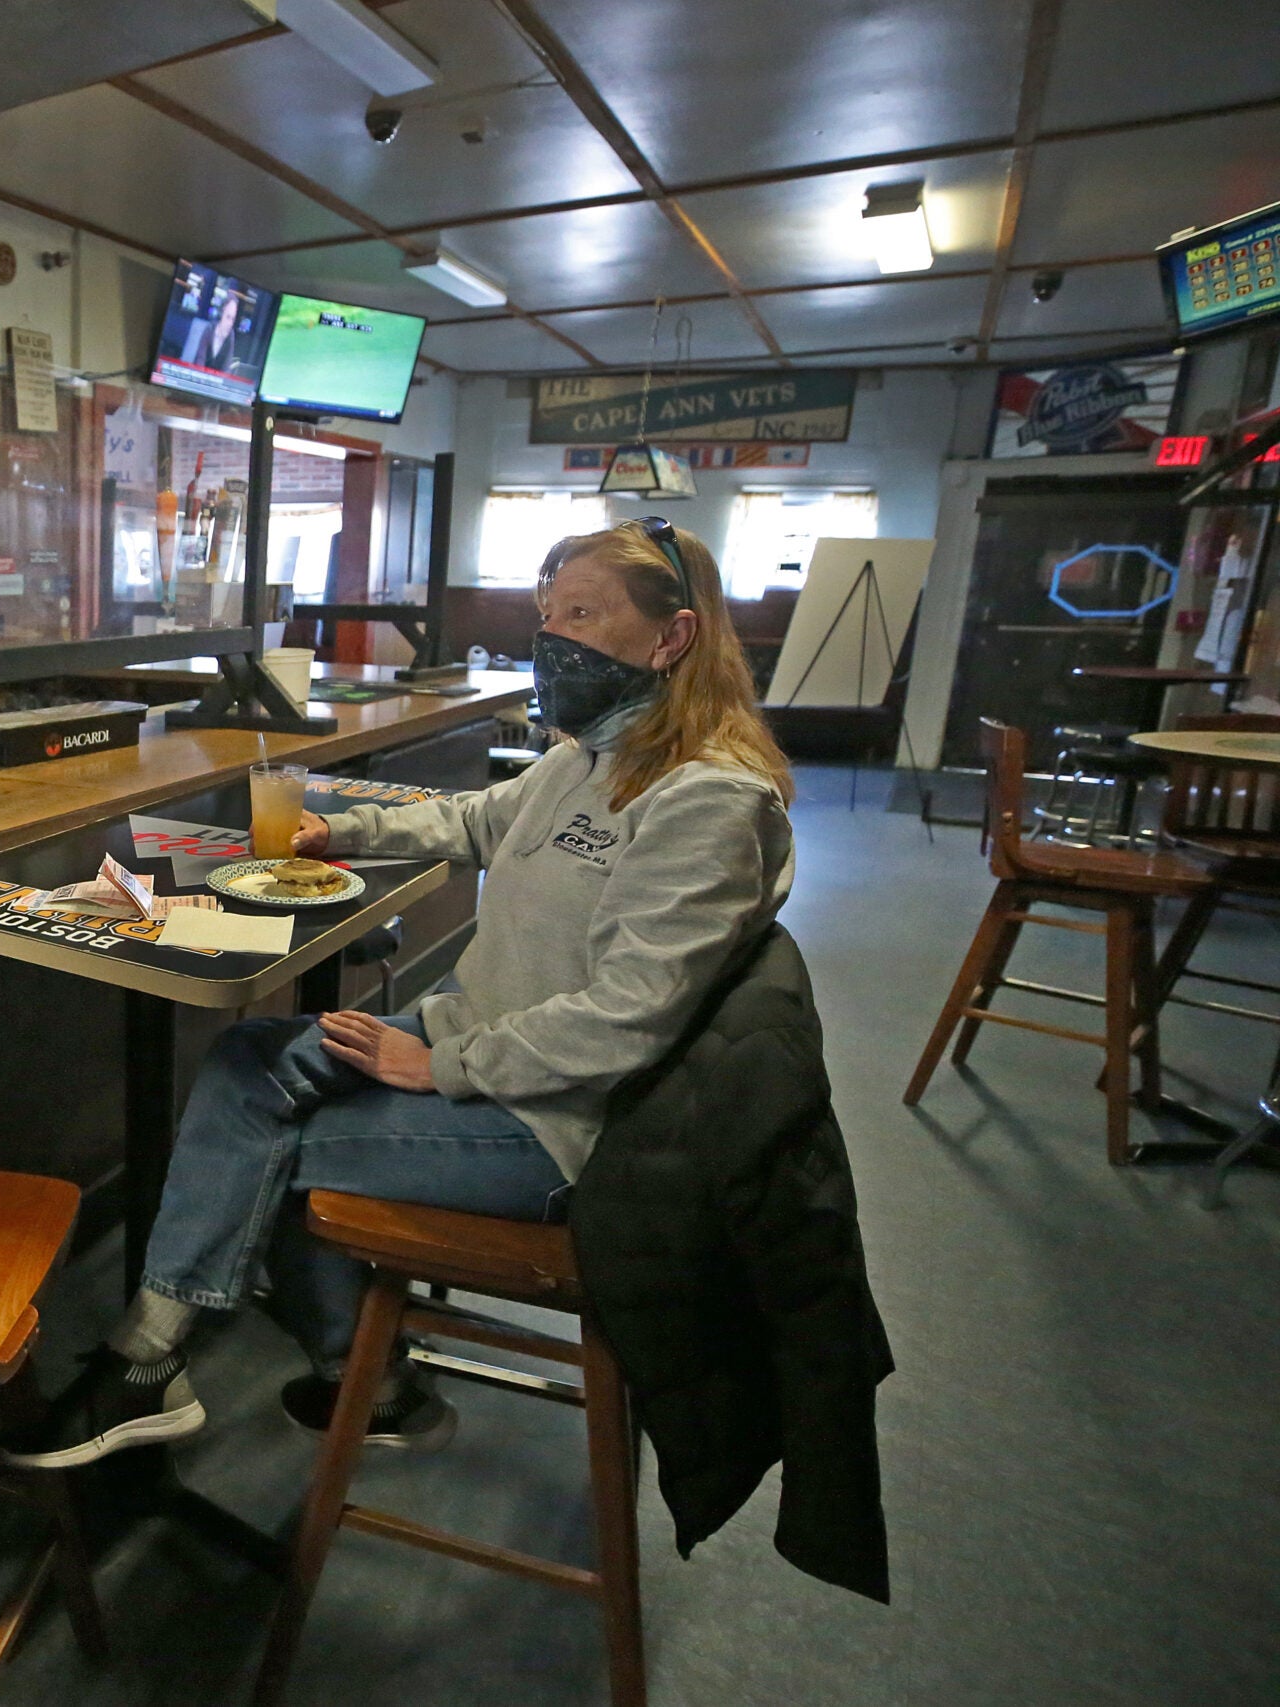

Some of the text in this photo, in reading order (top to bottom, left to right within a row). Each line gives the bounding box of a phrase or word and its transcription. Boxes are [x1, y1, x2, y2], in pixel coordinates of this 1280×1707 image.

[547, 378, 591, 397] THE
[573, 382, 796, 433] CAPE ANN VETS
[1156, 436, 1208, 466] EXIT
[63, 730, 110, 750] BACARDI
[334, 777, 442, 795] BOSTON
[567, 813, 620, 845] Pratty's
